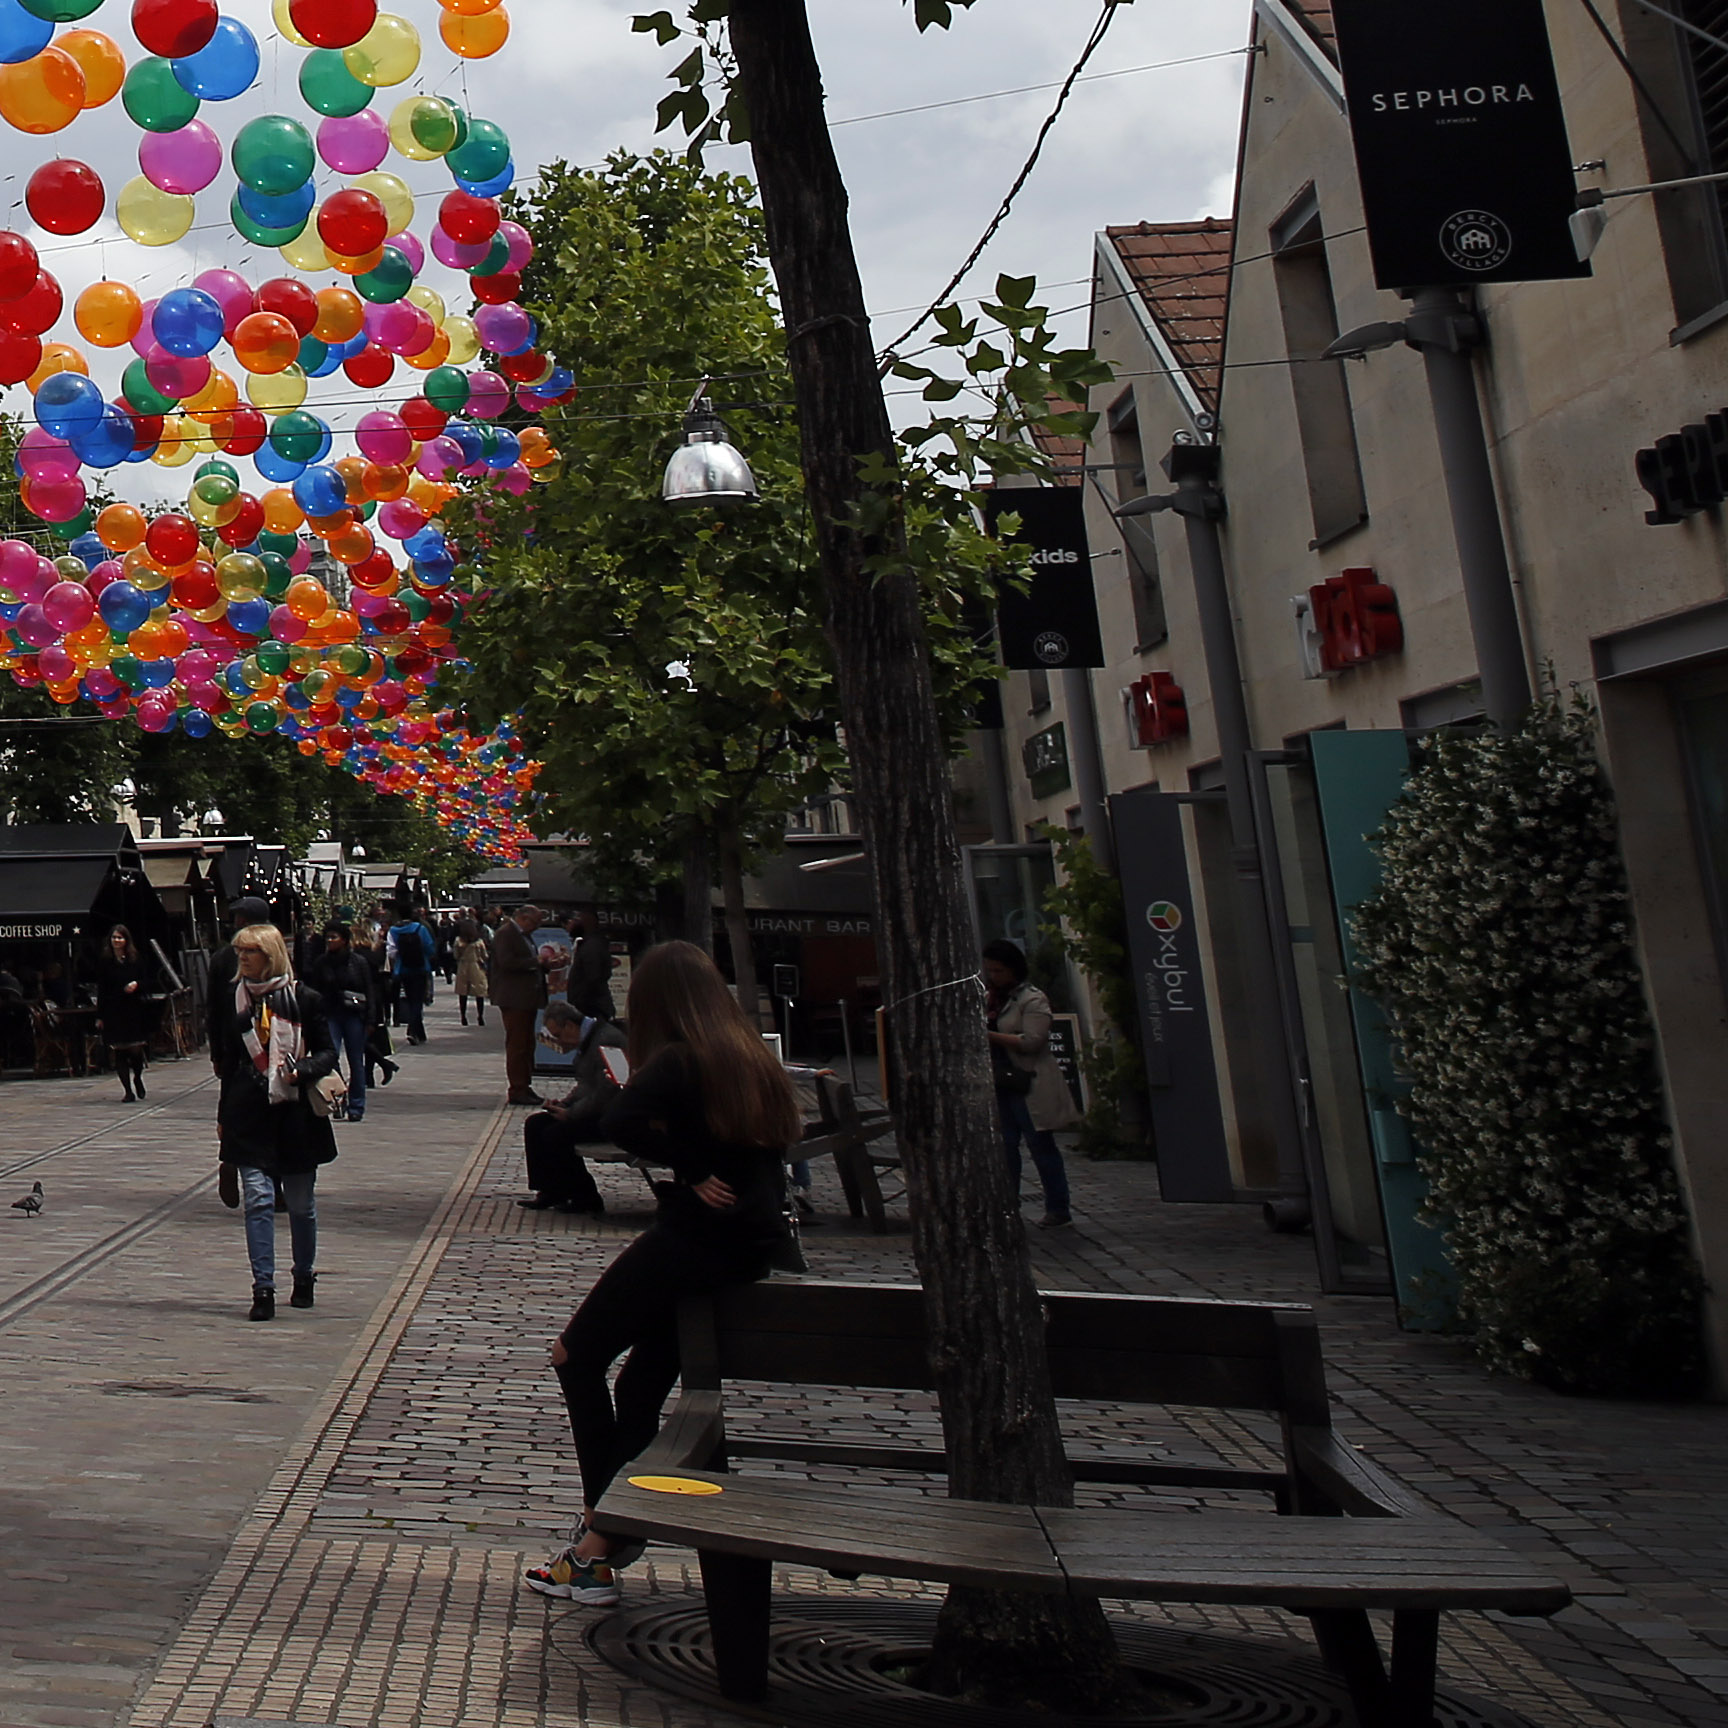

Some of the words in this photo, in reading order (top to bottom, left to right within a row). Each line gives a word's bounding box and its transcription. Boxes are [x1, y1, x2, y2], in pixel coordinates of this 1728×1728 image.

[1371, 83, 1534, 112] SEPHORA
[1448, 214, 1497, 230] BERCY
[1451, 247, 1505, 267] VILLAGE
[595, 911, 657, 927] BRUN
[826, 920, 870, 934] BAR
[34, 924, 62, 937] SHOP
